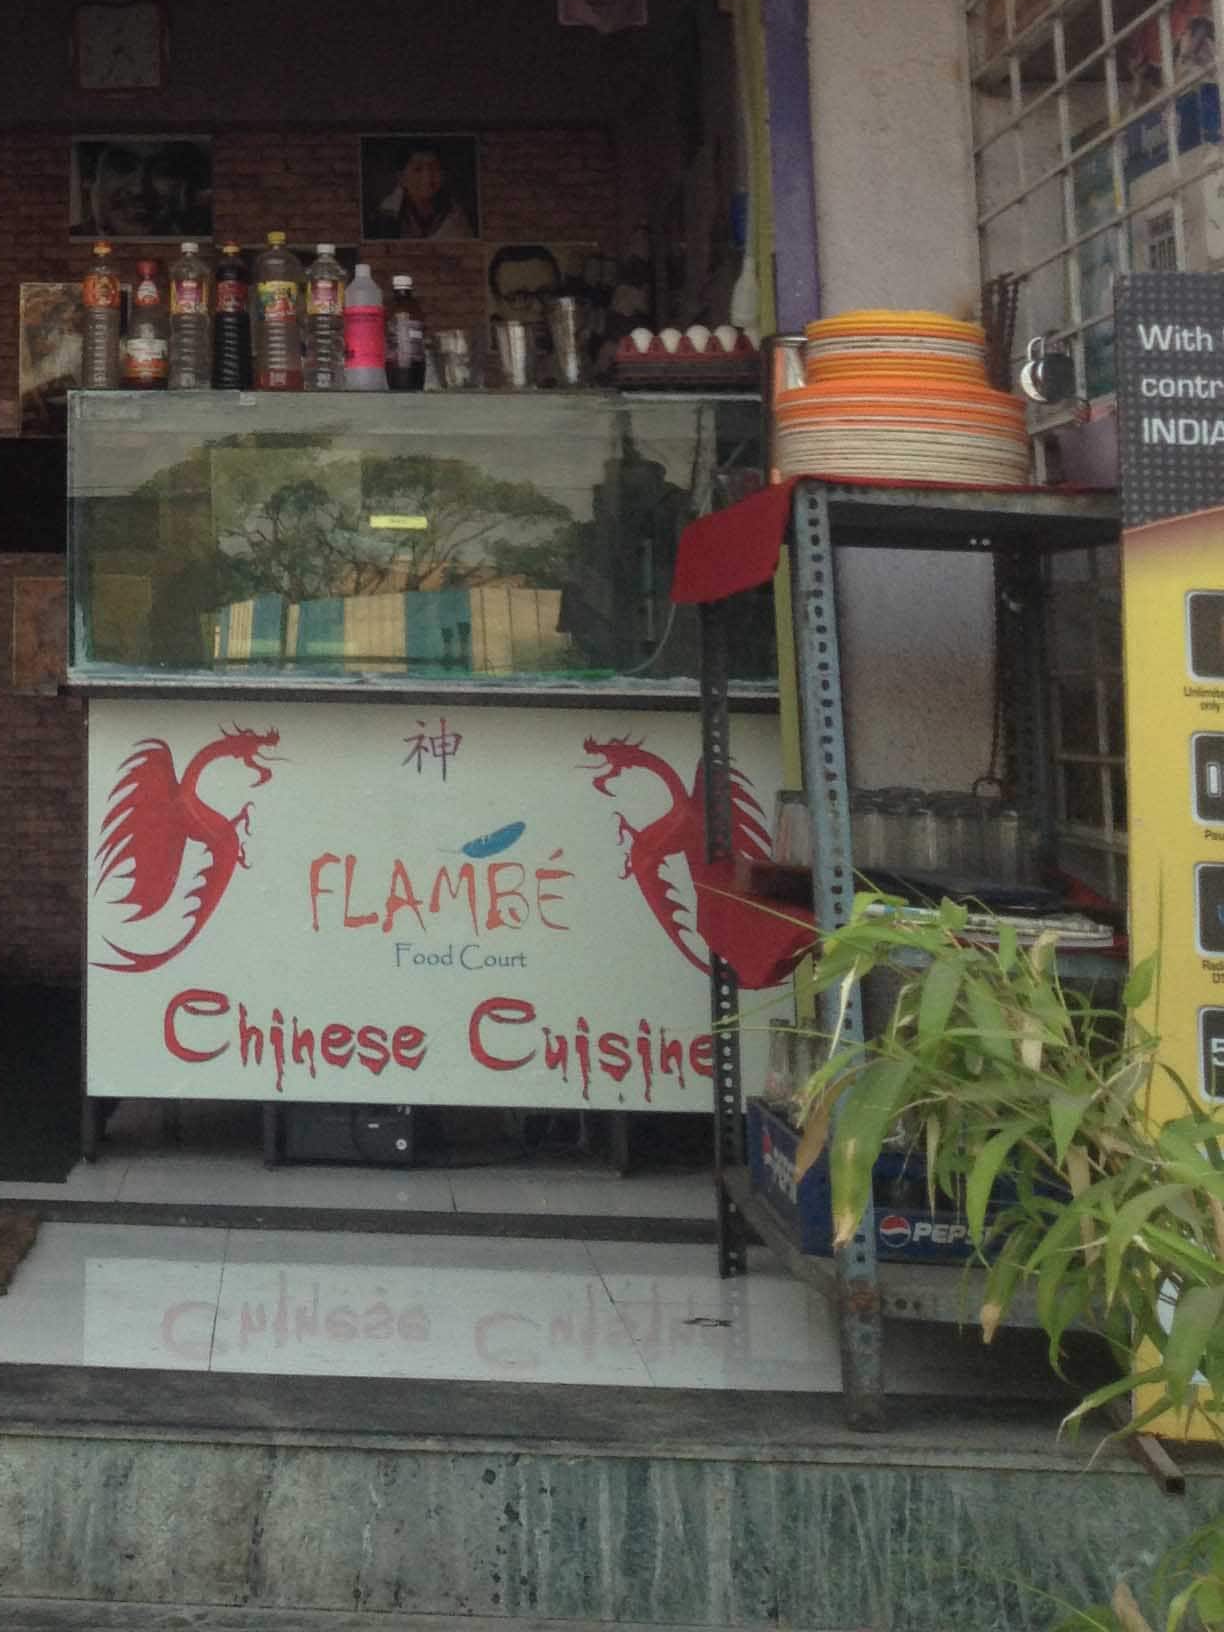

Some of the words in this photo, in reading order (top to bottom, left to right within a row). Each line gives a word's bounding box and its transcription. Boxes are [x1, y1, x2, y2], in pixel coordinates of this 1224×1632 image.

[1137, 324, 1214, 353] With
[1140, 375, 1224, 399] contr
[402, 718, 462, 782] 神
[310, 850, 576, 934] FLAMBÉ
[395, 942, 454, 969] Food
[459, 942, 528, 971] Court
[163, 989, 426, 1091] Chinese
[468, 997, 715, 1102] Cuisine
